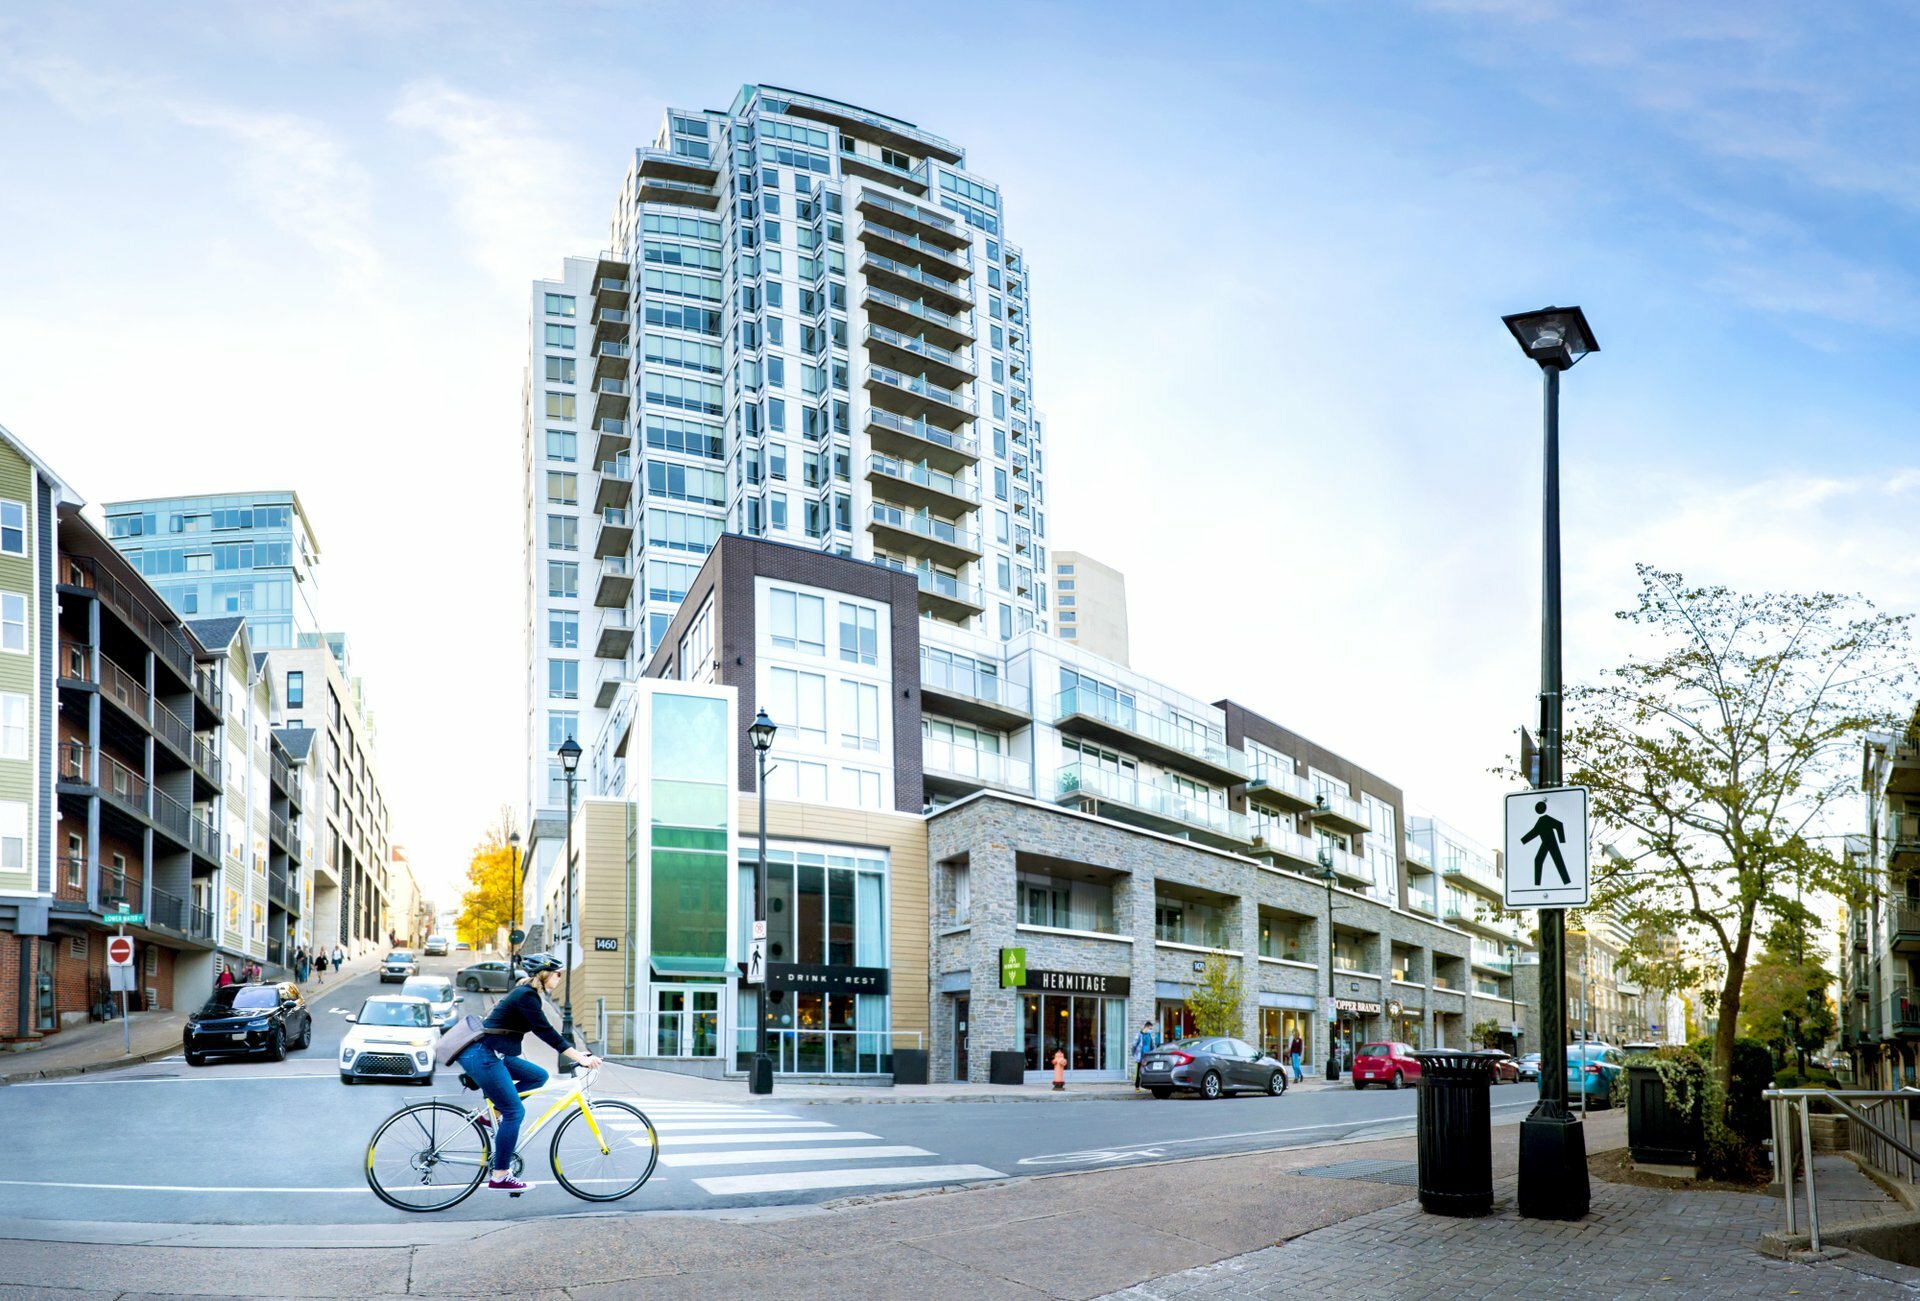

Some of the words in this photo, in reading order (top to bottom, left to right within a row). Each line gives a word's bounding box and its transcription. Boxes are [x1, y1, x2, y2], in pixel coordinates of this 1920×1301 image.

[596, 939, 617, 949] 1460
[788, 973, 827, 982] DRINK
[845, 976, 876, 984] REST
[1042, 973, 1106, 991] HERMITAGE
[1335, 1000, 1357, 1011] OPPER
[1357, 1002, 1380, 1014] BRANCH
